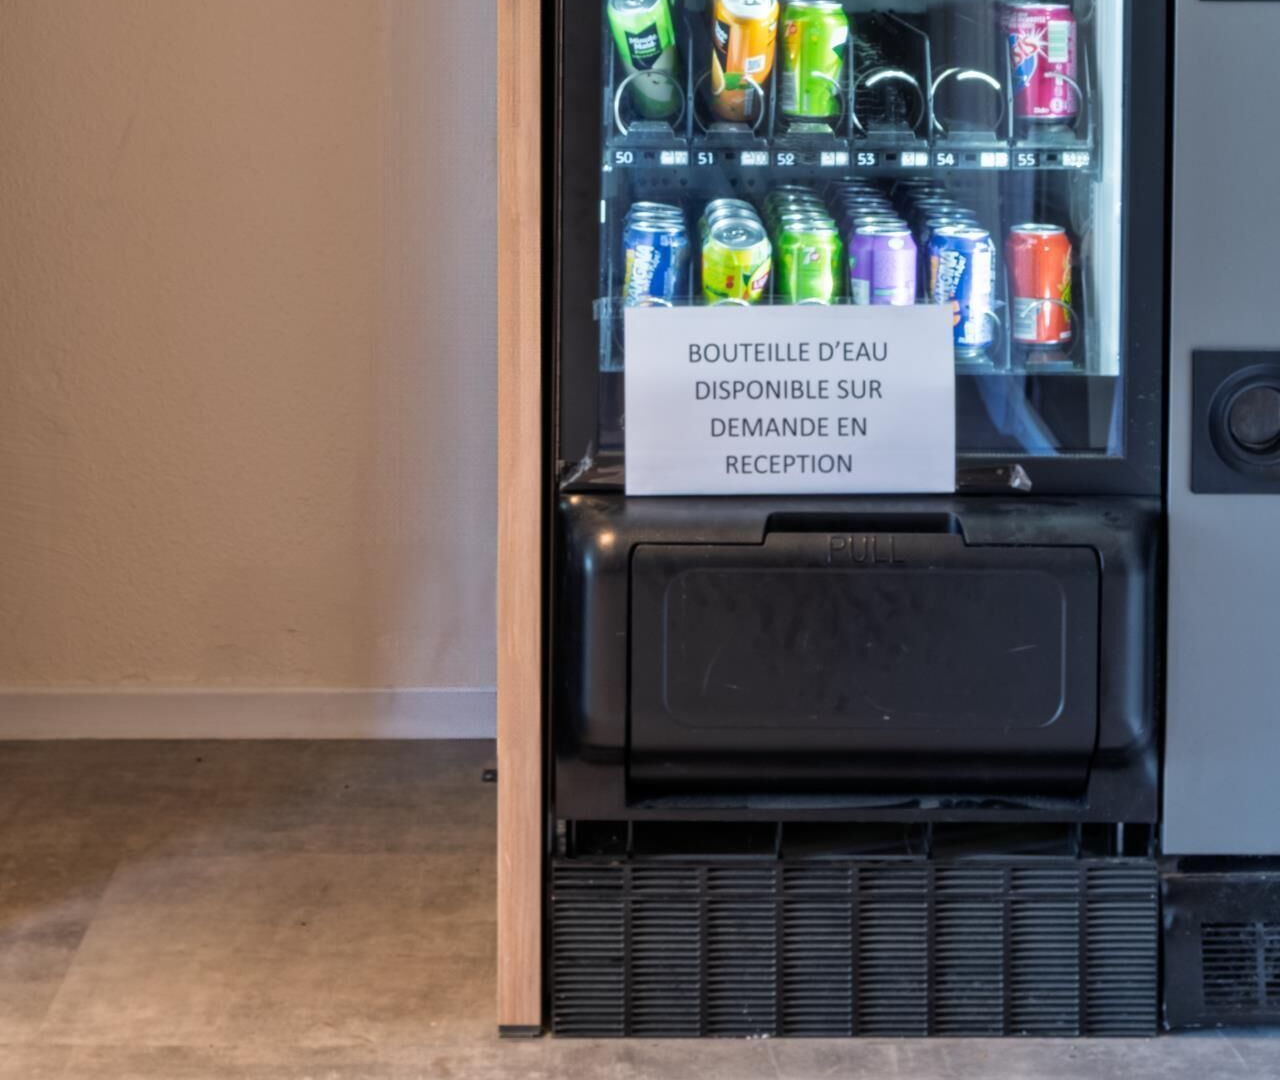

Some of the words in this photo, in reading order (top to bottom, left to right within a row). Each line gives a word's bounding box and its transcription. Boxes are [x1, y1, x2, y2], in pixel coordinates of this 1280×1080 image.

[615, 151, 634, 164] 50
[697, 152, 714, 165] 51
[777, 153, 795, 166] 52
[857, 153, 876, 166] 53
[937, 153, 955, 166] 54
[1018, 153, 1036, 166] 55
[688, 342, 811, 363] BOUTEILLE
[818, 340, 889, 362] D’EAU
[695, 380, 830, 401] DISPONIBLE
[837, 379, 883, 400] SUR
[711, 417, 830, 438] DEMANDE
[837, 416, 867, 437] EN
[725, 453, 853, 474] RECEPTION
[826, 534, 905, 564] PULL
